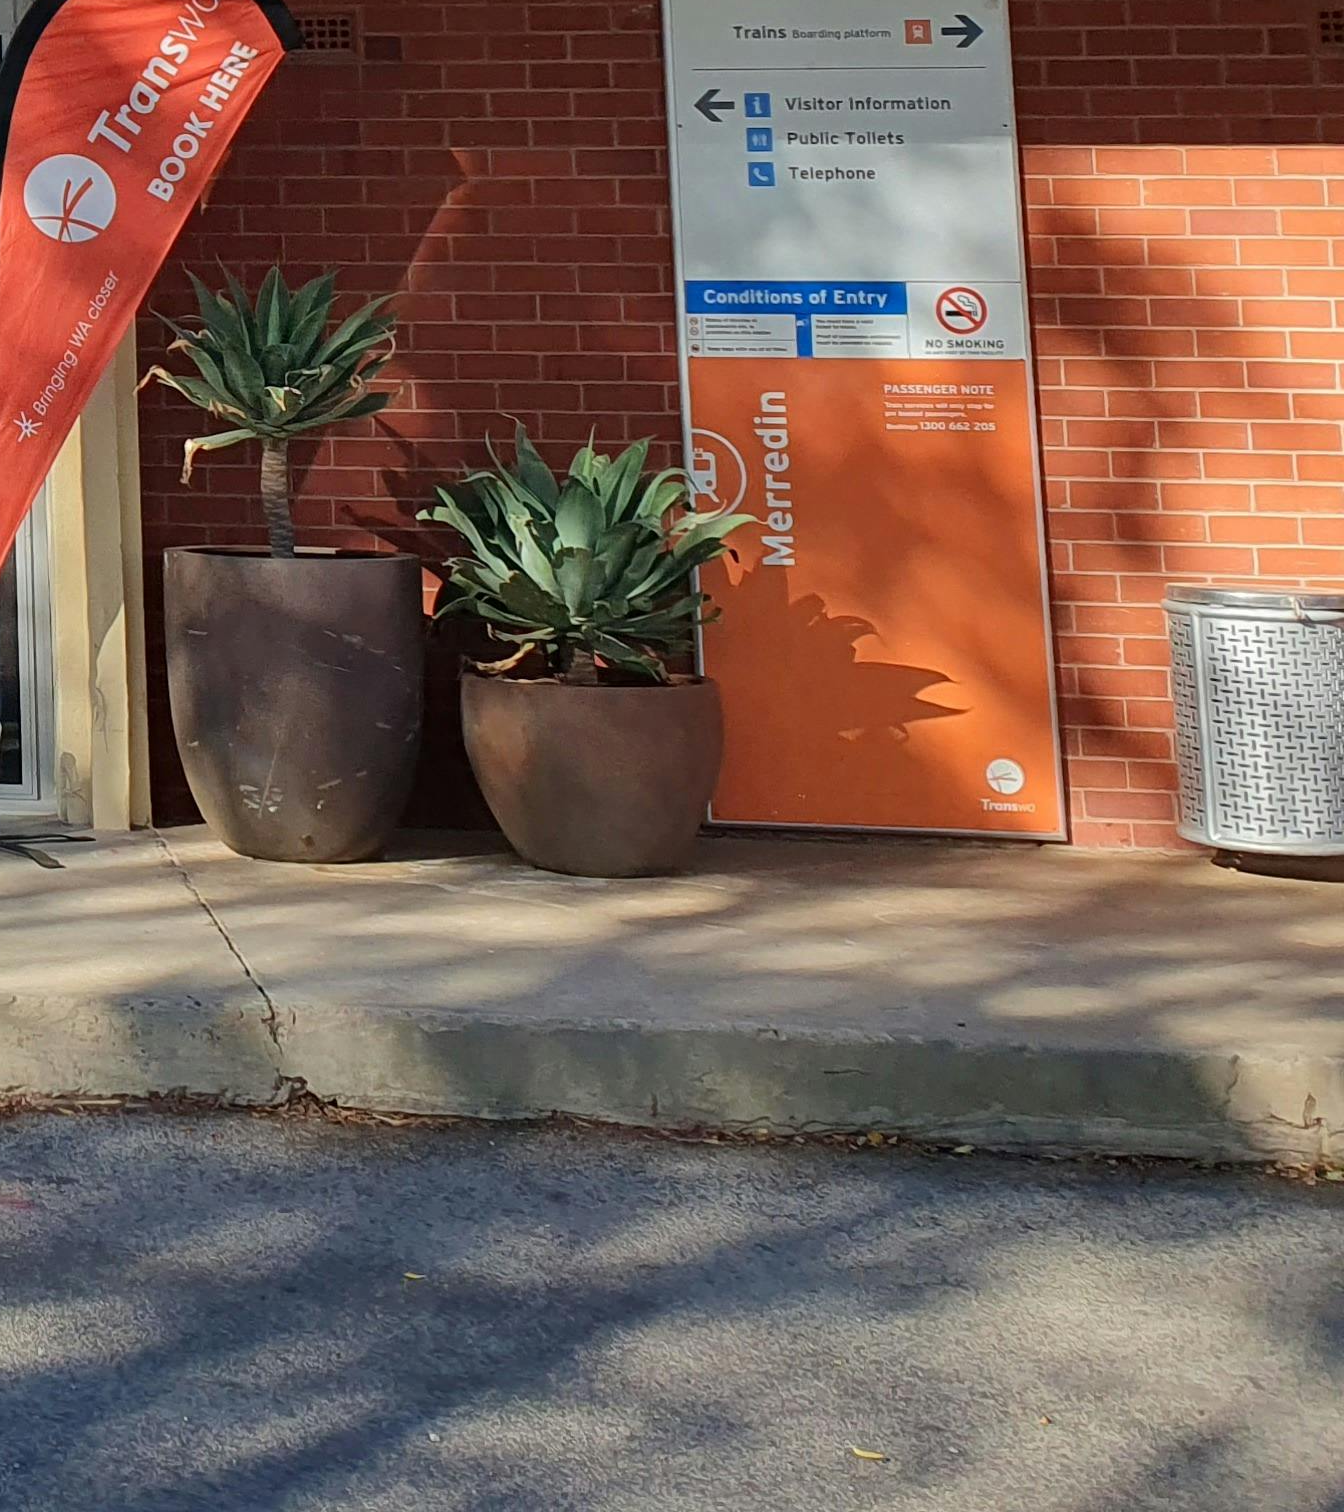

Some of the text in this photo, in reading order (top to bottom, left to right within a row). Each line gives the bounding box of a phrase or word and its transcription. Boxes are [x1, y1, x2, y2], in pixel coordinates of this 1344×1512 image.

[732, 25, 892, 40] Trains Boarding platform
[785, 96, 843, 111] Visitor
[849, 96, 952, 111] Information
[146, 40, 259, 202] BOOK HERE
[786, 131, 905, 145] Public Toilets
[788, 166, 877, 182] Telephone
[703, 289, 888, 308] Conditions of Entry
[32, 269, 119, 416] Bringing WA closer
[925, 339, 1005, 349] NO SMOKING
[883, 384, 995, 395] PASSENGER NOTE
[919, 421, 946, 431] 1300
[753, 390, 796, 567] Merredin
[980, 798, 1036, 814] Transwa
